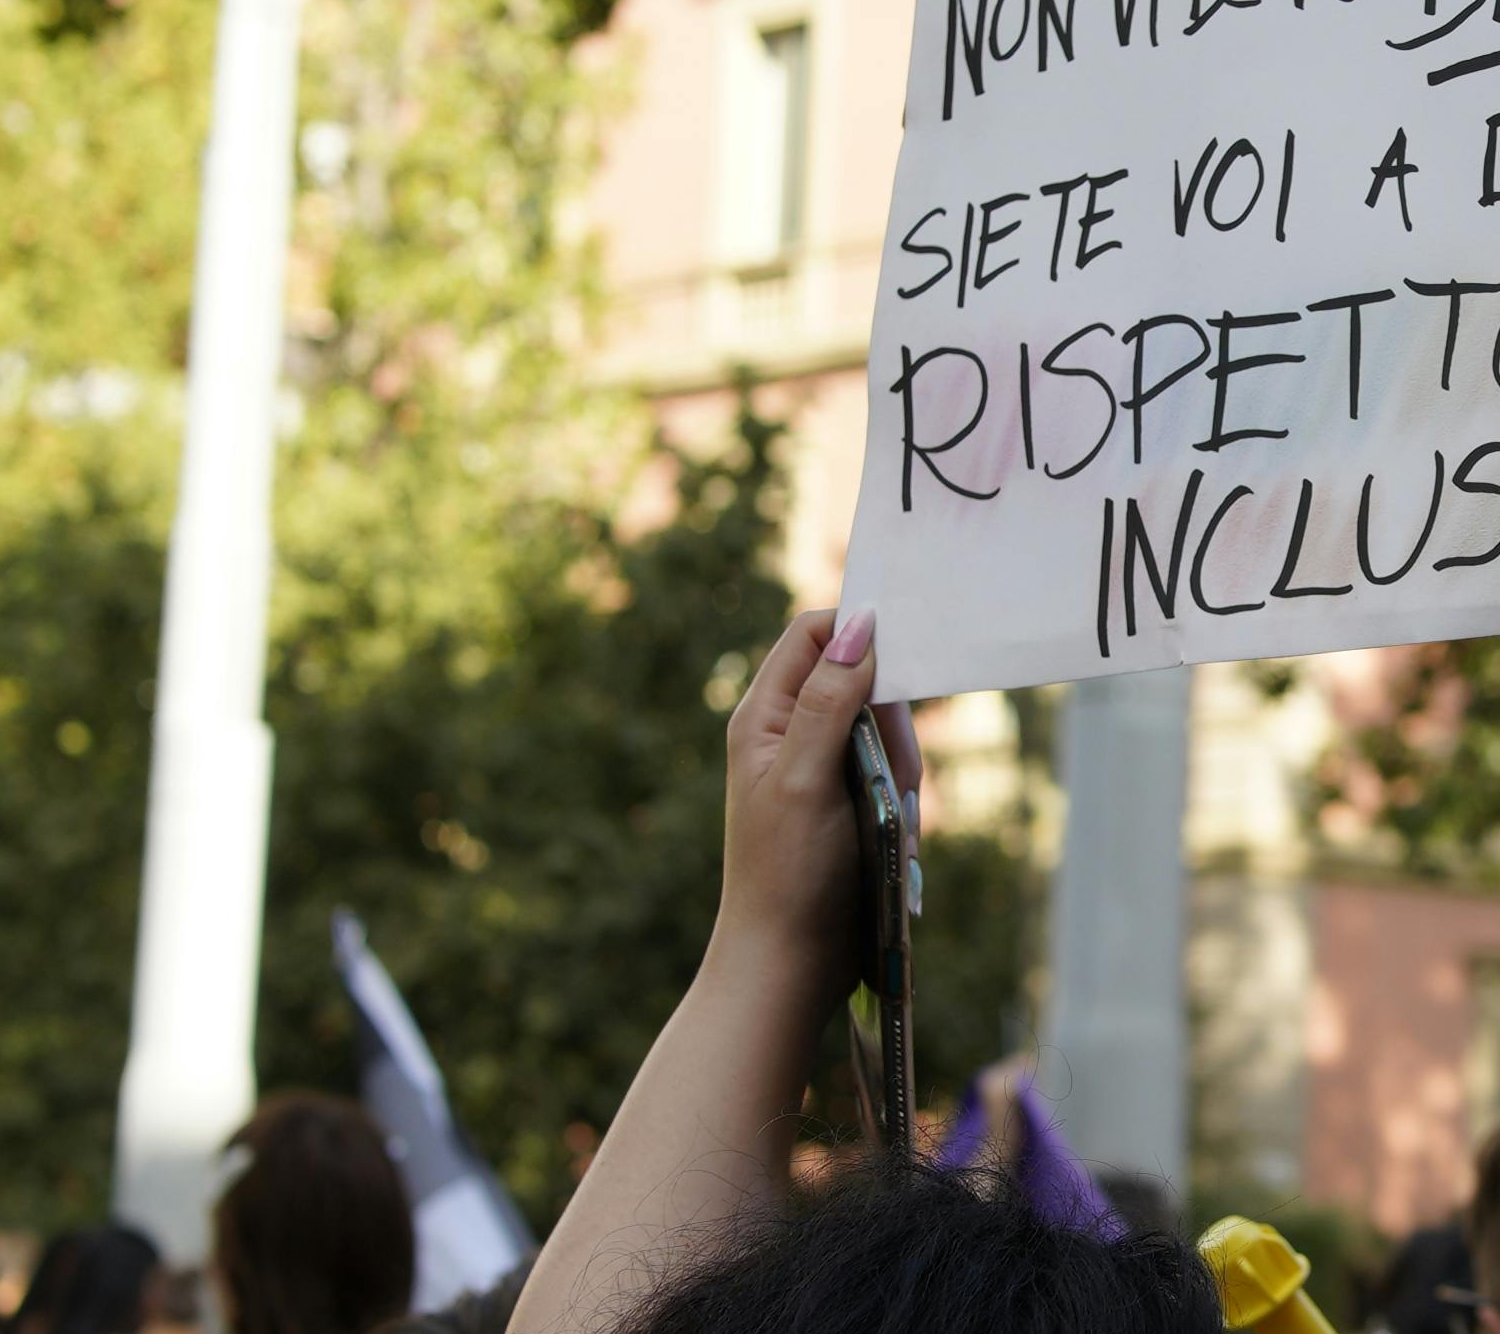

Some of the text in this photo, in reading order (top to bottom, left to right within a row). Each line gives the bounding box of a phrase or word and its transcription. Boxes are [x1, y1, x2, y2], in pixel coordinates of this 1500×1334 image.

[895, 167, 1126, 310] SIETE
[1172, 127, 1297, 244] VOI
[1362, 125, 1418, 234] A
